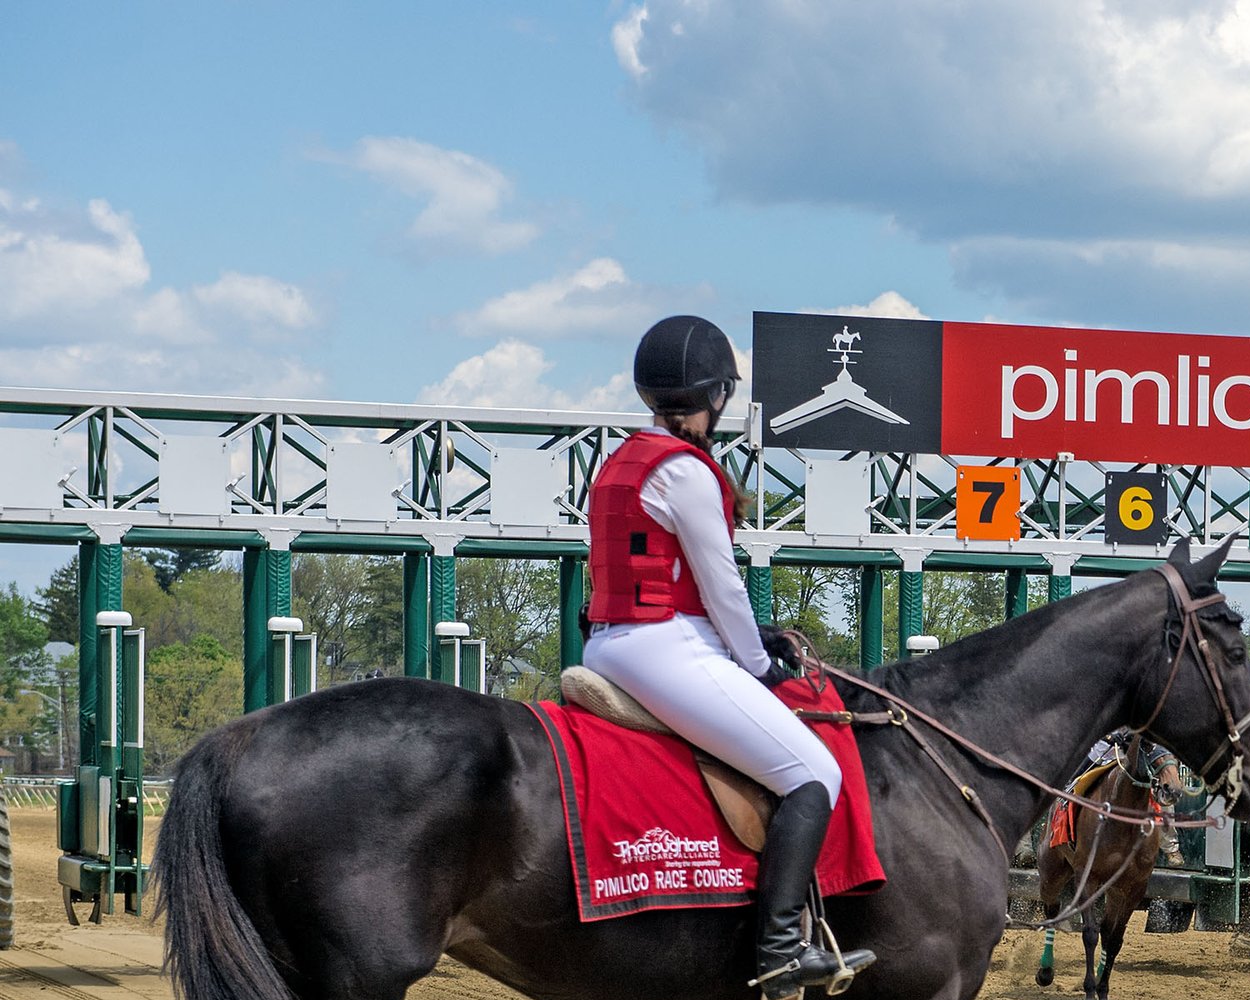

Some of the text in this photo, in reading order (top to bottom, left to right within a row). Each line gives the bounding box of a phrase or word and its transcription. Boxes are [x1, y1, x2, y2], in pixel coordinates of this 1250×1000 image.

[972, 481, 1005, 523] 7
[1118, 486, 1154, 530] 6
[612, 834, 719, 858] Thoroughbred
[621, 850, 721, 865] AFTERCARE ALLIANCE
[595, 868, 744, 898] PIMLICO RACE COURSE
